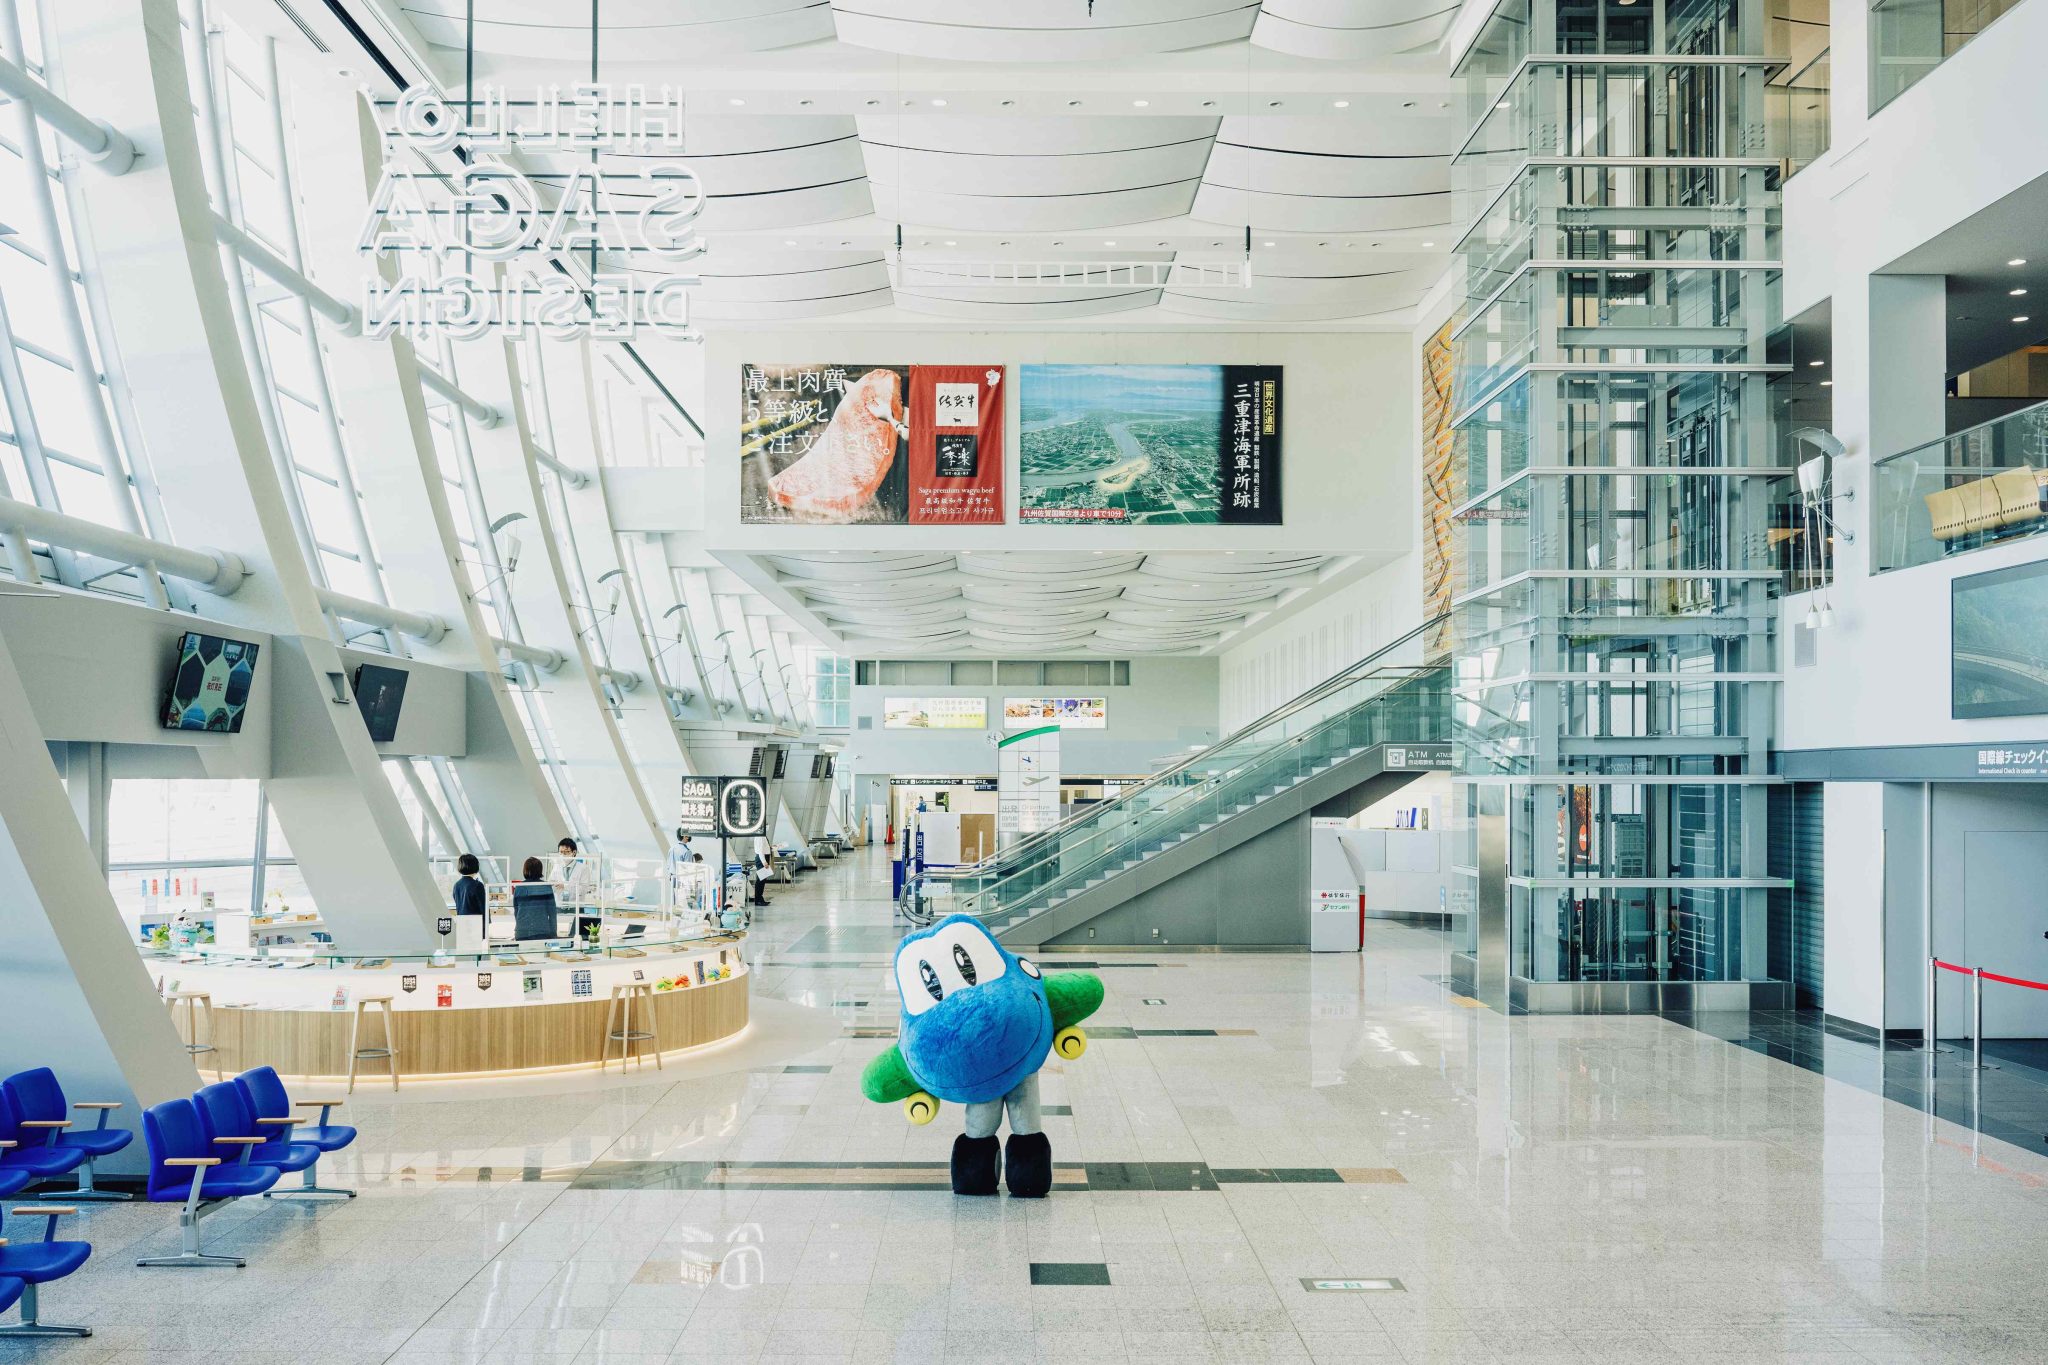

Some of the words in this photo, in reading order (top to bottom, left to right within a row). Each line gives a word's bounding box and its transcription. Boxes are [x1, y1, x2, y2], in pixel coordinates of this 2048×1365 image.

[746, 369, 847, 393] 最上肉質
[1264, 382, 1273, 433] 世界文化遺産
[1233, 383, 1251, 508] 三重津海軍所跡
[919, 487, 932, 495] Saga
[933, 487, 960, 495] premium
[683, 783, 712, 796] SAGA
